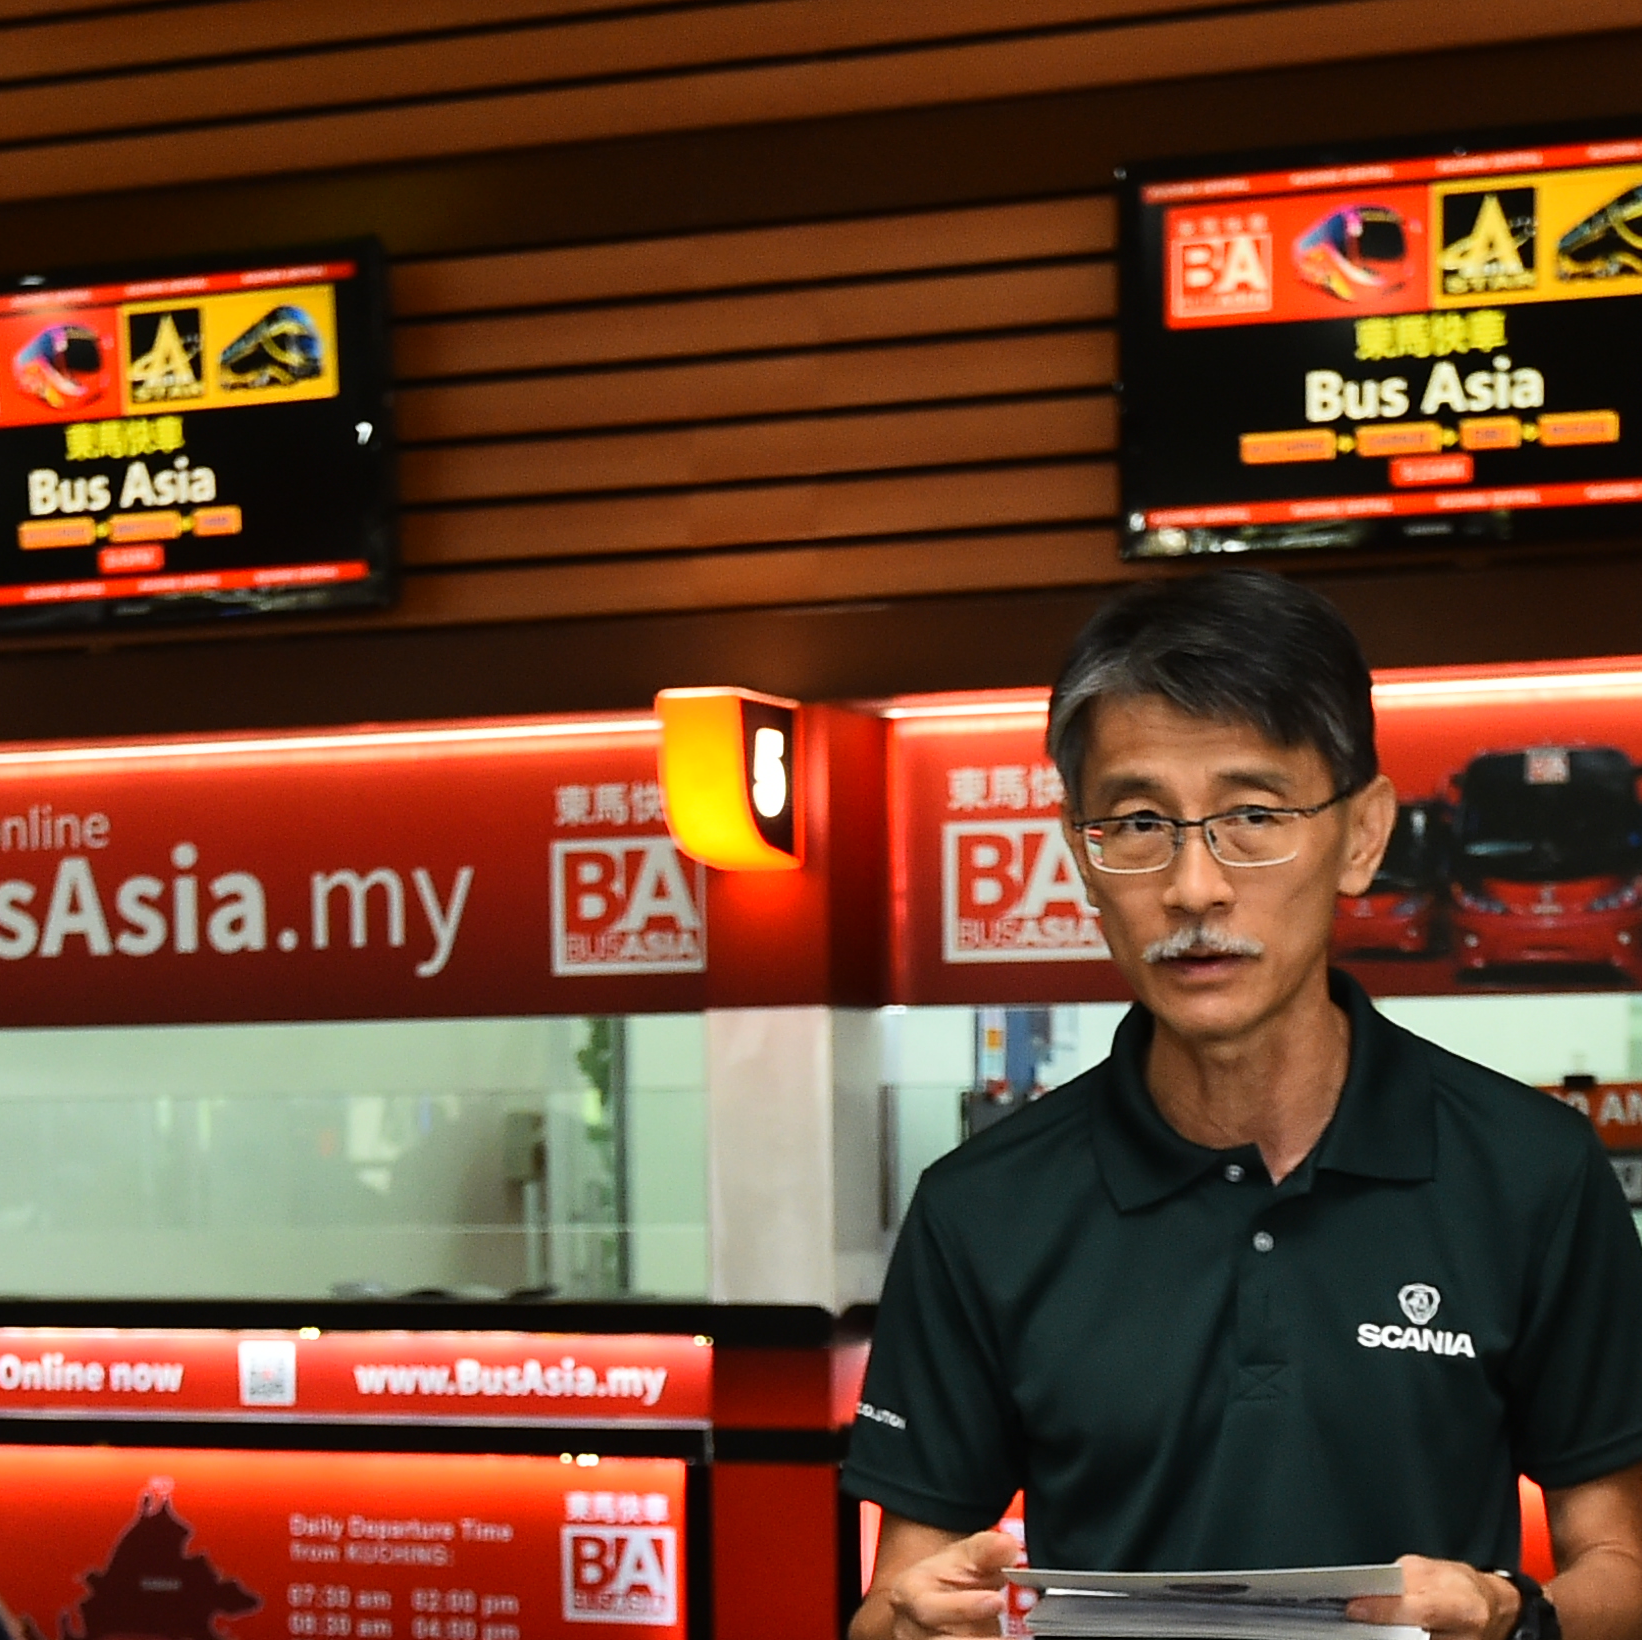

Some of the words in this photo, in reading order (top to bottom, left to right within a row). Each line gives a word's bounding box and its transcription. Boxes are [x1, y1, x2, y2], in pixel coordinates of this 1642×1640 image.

[1305, 370, 1409, 421] Bus
[1420, 354, 1544, 414] Asia
[28, 468, 111, 515] Bus
[120, 455, 216, 508] Asia
[556, 781, 664, 827] 東馬快
[947, 764, 1065, 810] 東馬快
[1357, 1323, 1475, 1358] SCANIA
[109, 1363, 184, 1393] now
[354, 1357, 667, 1406] www.BusAsia.my
[289, 1513, 343, 1541] Daily
[348, 1514, 455, 1541] Departure
[461, 1518, 514, 1543] Time
[290, 1540, 340, 1563] from
